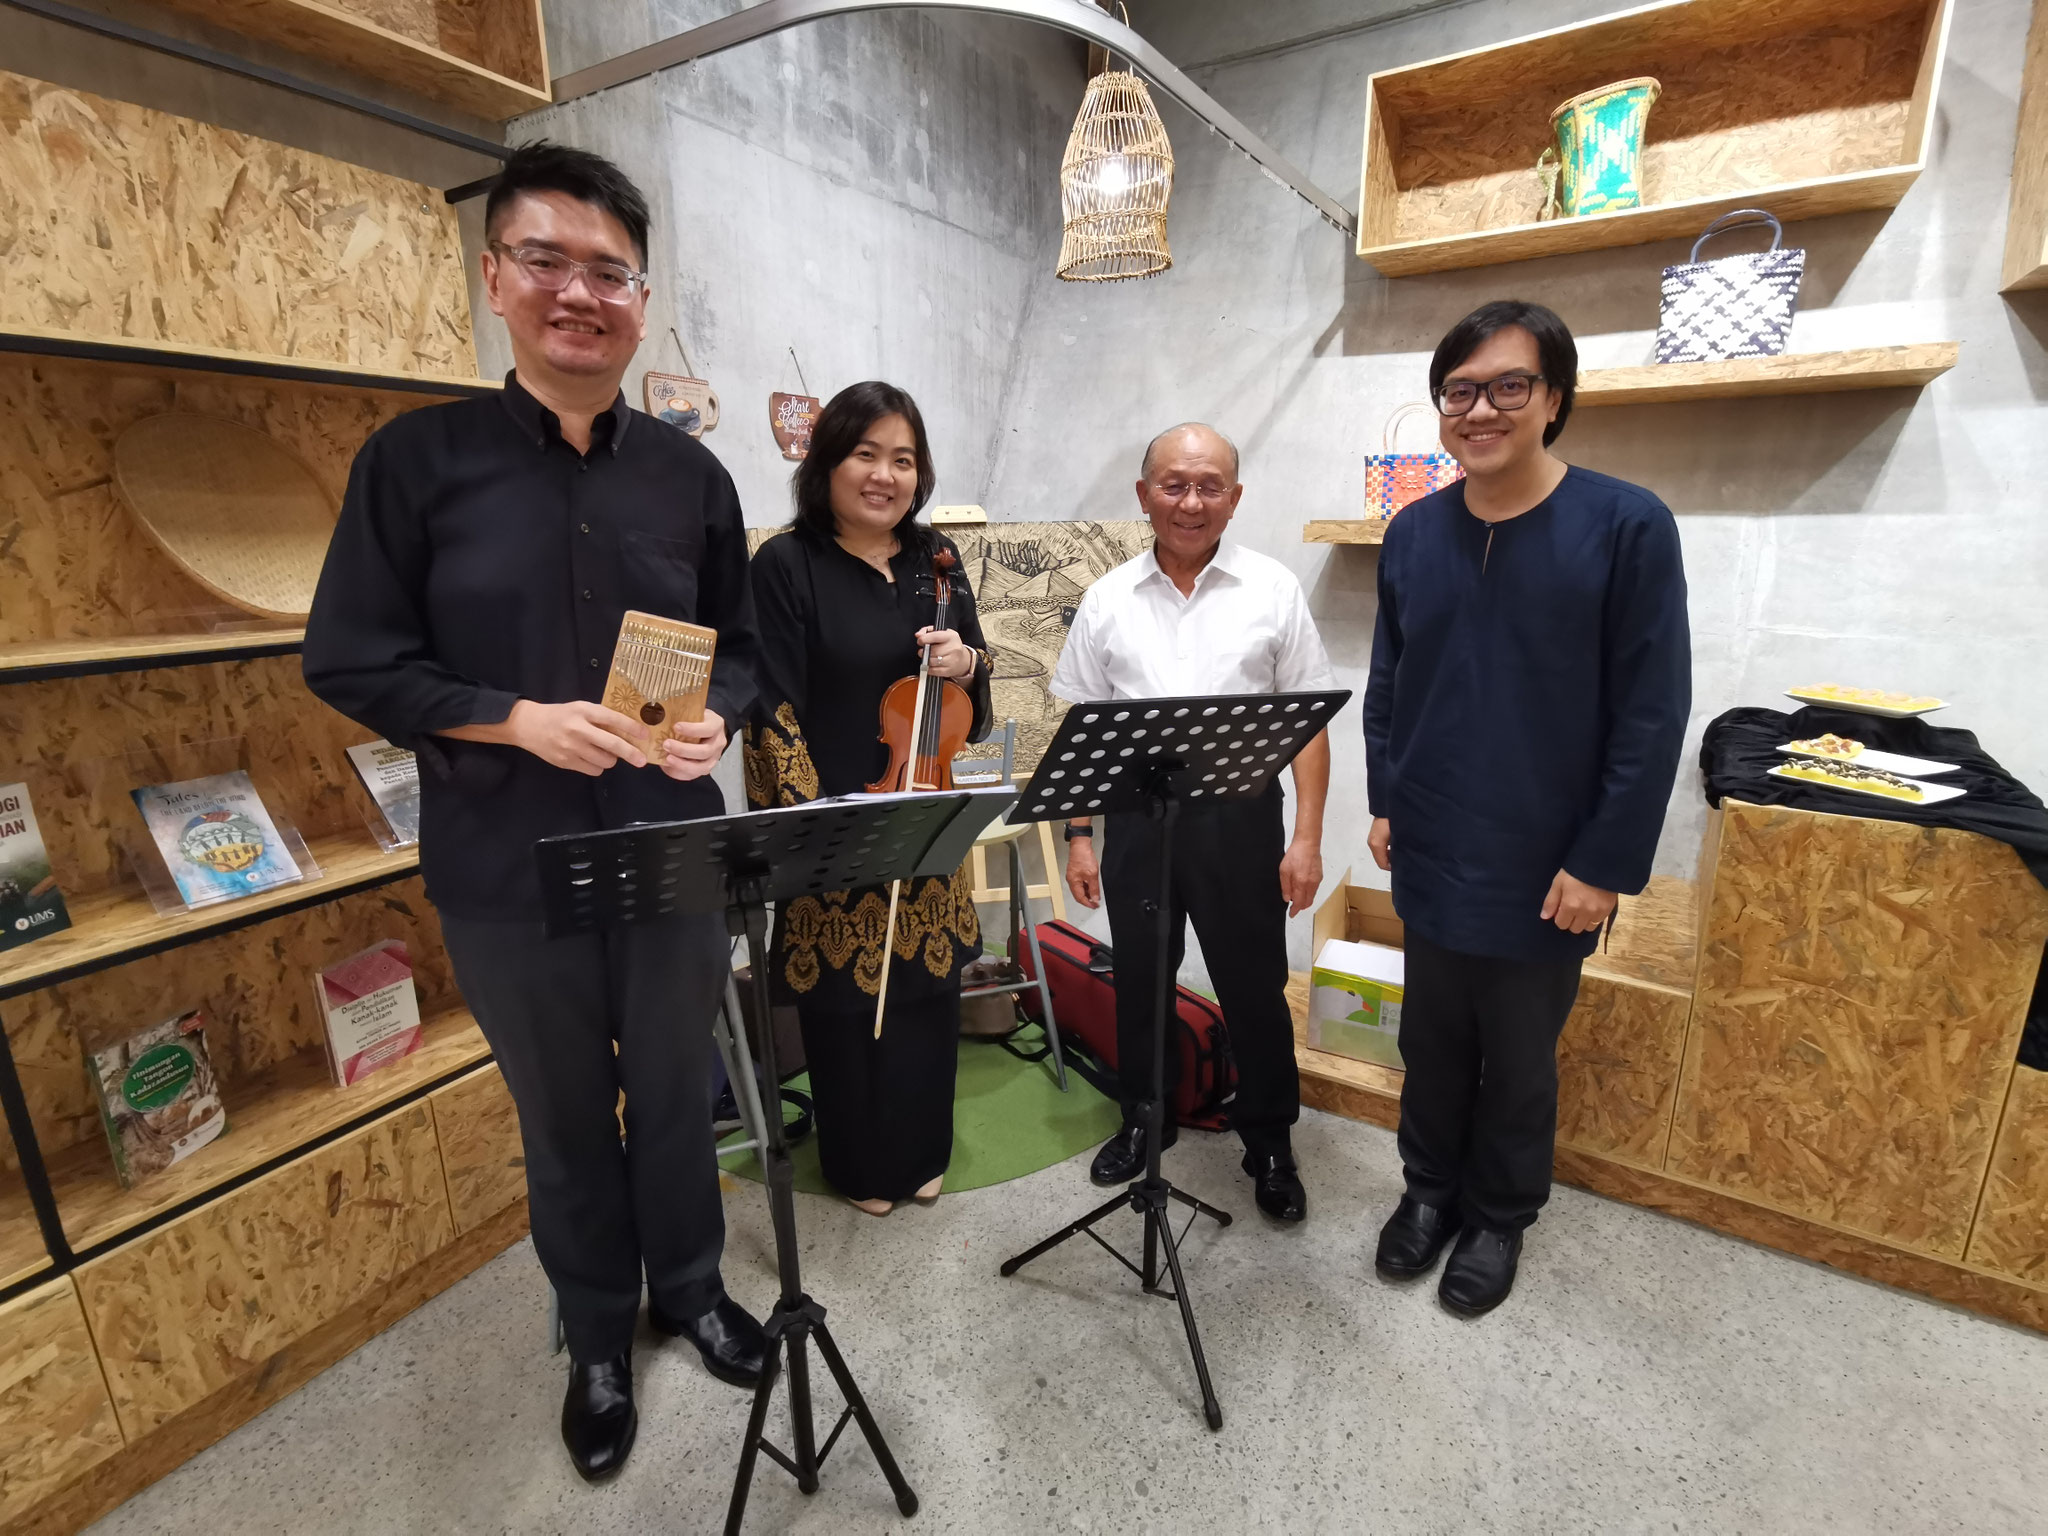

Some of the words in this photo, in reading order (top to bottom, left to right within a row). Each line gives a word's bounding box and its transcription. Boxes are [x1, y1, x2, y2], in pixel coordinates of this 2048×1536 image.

[653, 381, 676, 400] Coffee
[778, 396, 810, 416] Start
[778, 411, 810, 430] Coffee
[156, 793, 199, 806] Tales
[174, 806, 192, 815] LAND
[193, 801, 214, 812] BELOW
[228, 794, 246, 802] WIND
[28, 908, 56, 925] UMS
[341, 1000, 366, 1015] Disiplin
[373, 984, 402, 999] Hukuman
[351, 1000, 399, 1025] Kanak-kanak
[372, 1010, 393, 1023] Islam
